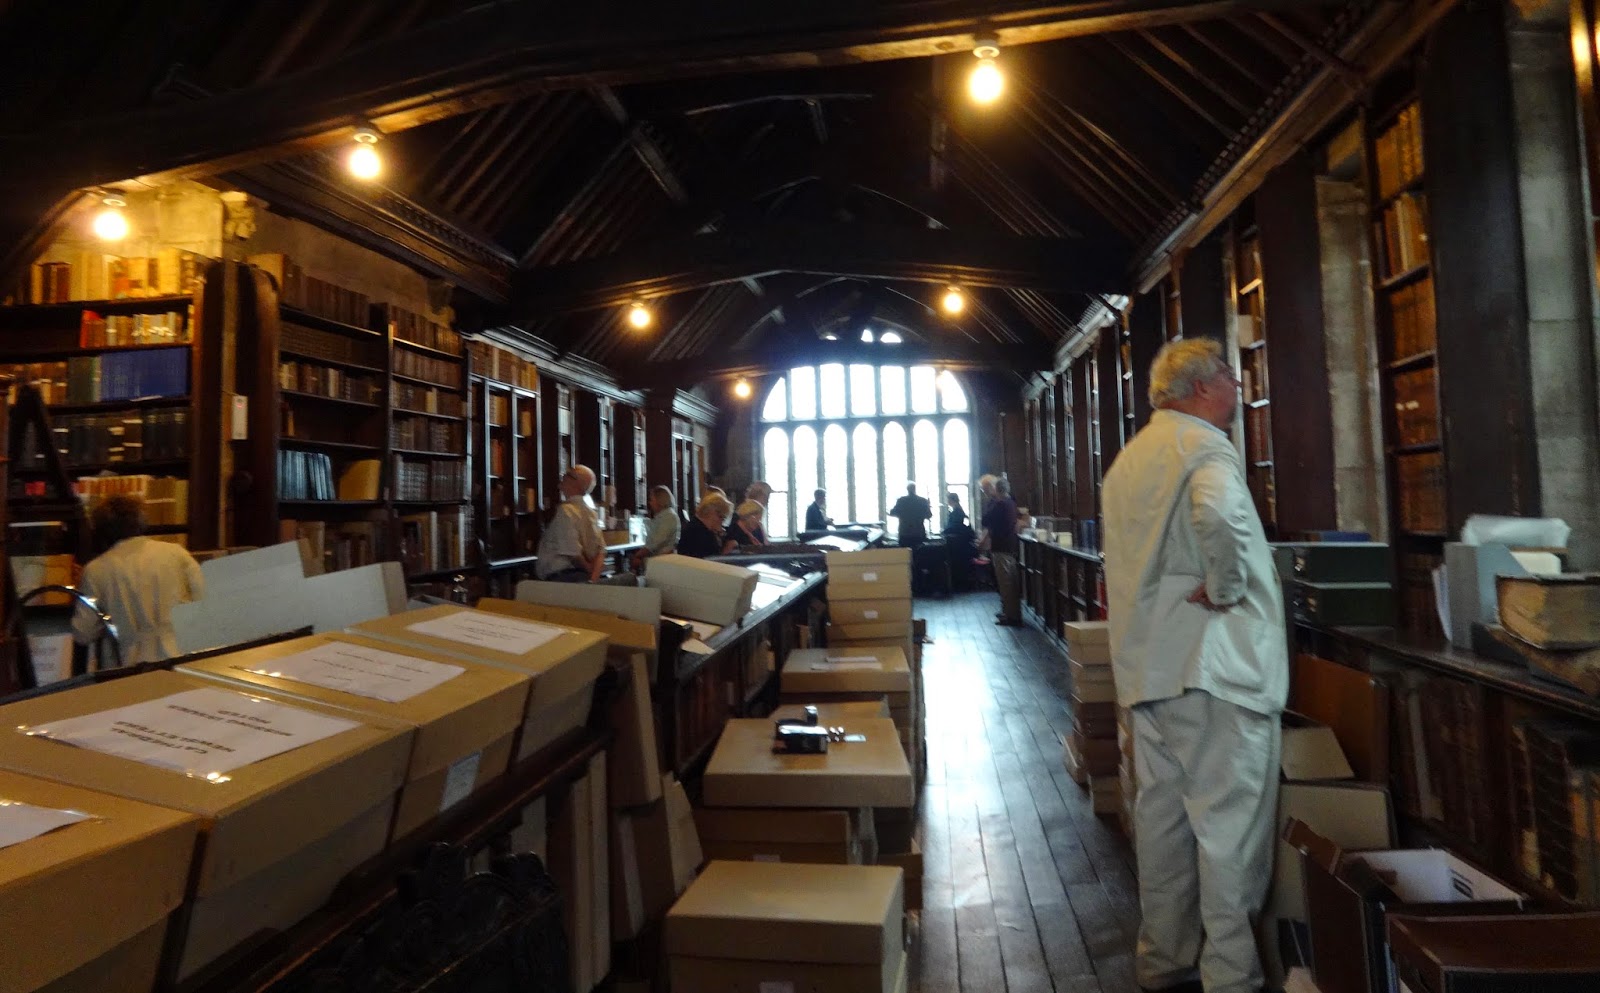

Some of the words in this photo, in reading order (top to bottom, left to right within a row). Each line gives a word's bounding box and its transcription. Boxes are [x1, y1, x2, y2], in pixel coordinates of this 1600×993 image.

[167, 705, 224, 721] ISSUES
[217, 710, 271, 724] NOTED
[113, 721, 236, 752] NEWSLETTERS
[225, 719, 293, 737] MISSING
[110, 727, 207, 754] CATHEDRAL
